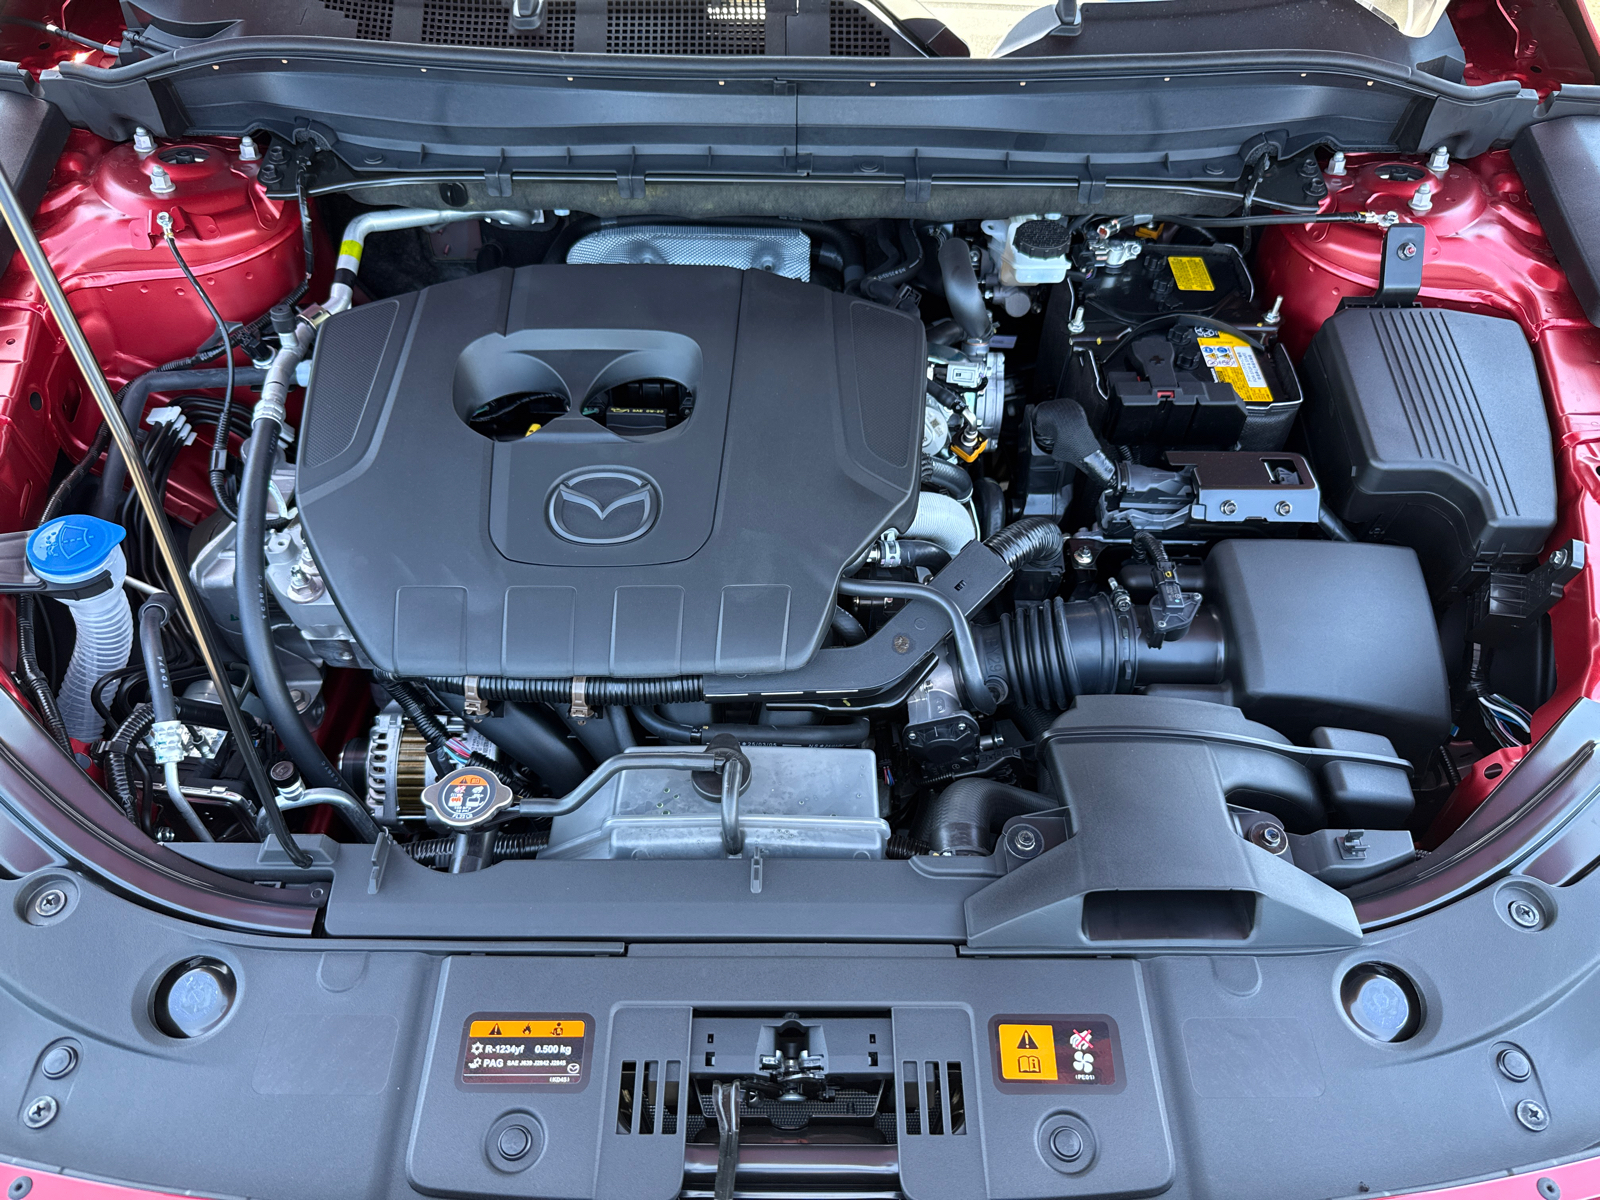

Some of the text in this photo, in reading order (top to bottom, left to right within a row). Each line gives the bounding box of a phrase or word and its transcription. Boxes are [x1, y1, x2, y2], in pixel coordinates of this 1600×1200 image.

[485, 1044, 572, 1055] R-1234yf 0.500 kg
[483, 1058, 504, 1068] PAG
